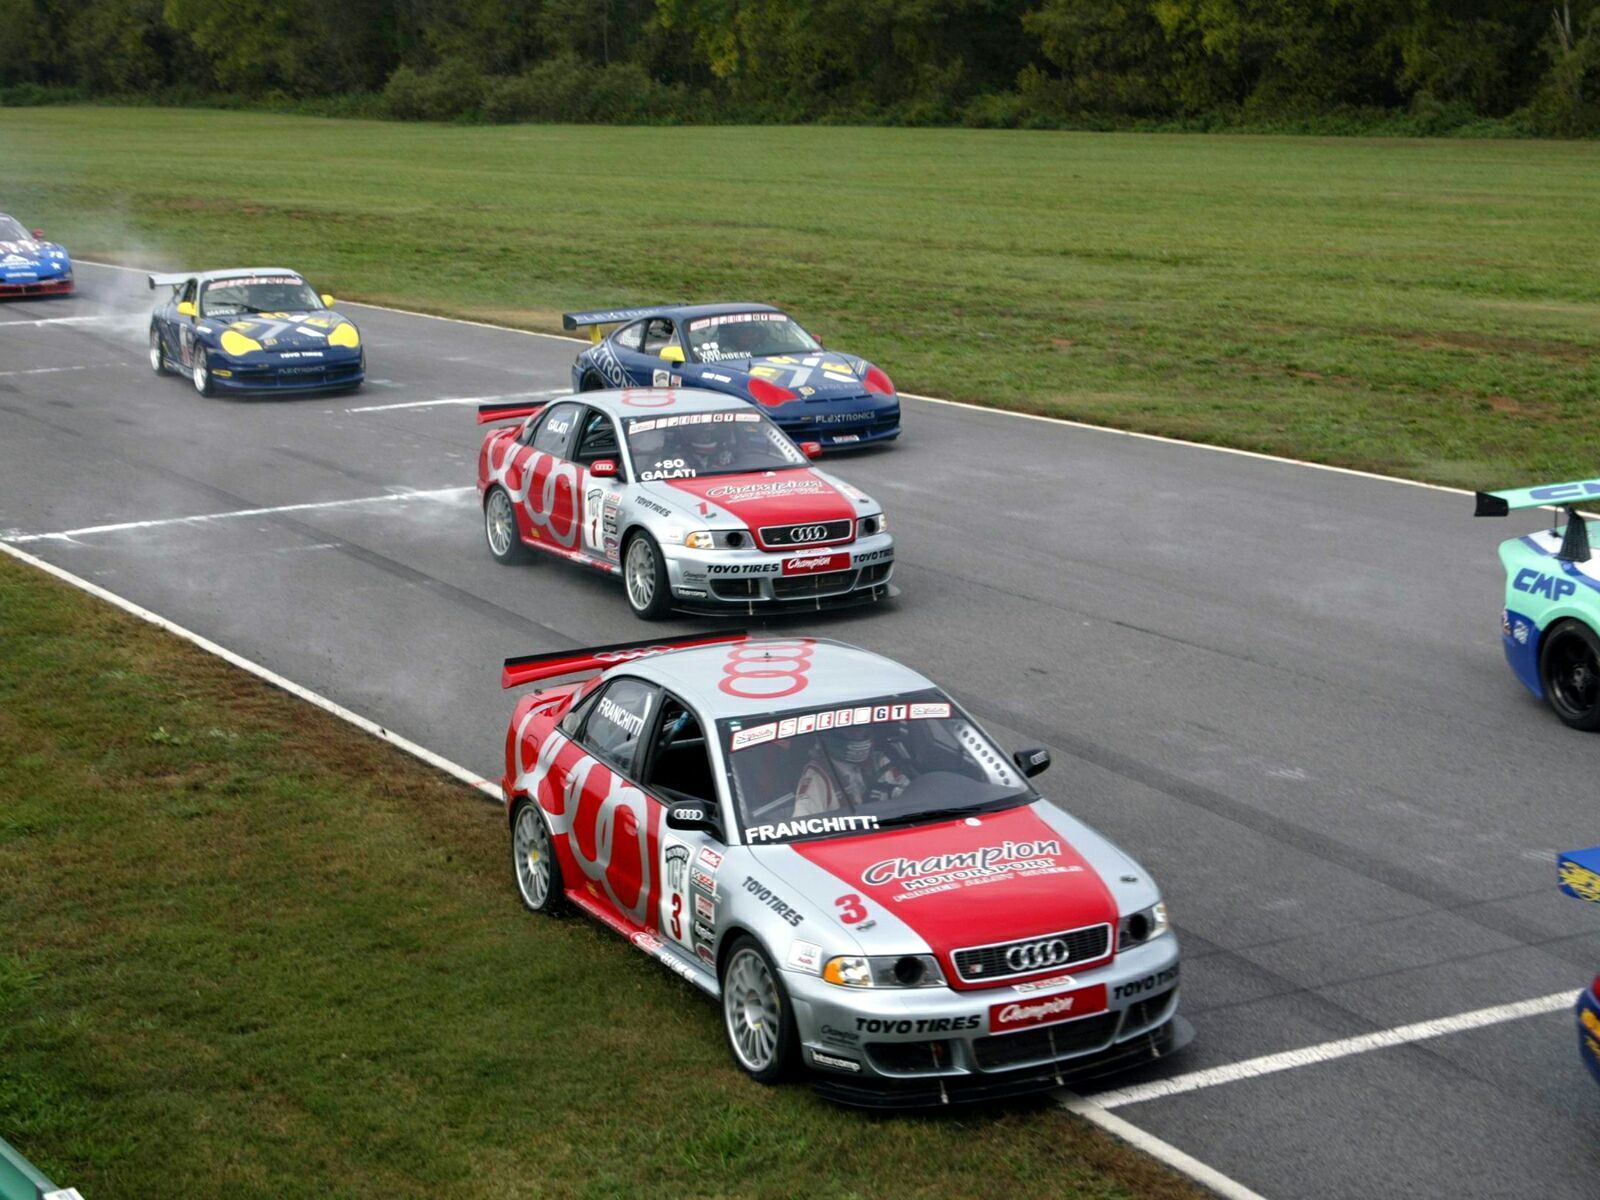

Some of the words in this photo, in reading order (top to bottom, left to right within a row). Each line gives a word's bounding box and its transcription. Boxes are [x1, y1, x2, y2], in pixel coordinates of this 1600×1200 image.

[641, 469, 696, 481] GALATI
[592, 518, 598, 548] 1
[707, 565, 740, 574] TOYO
[741, 563, 780, 573] TIRES
[787, 555, 831, 570] Champion
[853, 552, 878, 563] TOYO
[1512, 567, 1577, 602] CMP
[597, 696, 644, 737] FRANCHITTI
[875, 706, 906, 720] GT
[861, 840, 1062, 886] Champion
[902, 857, 1055, 891] MOTORSPORT
[742, 875, 771, 901] TOYO
[766, 895, 804, 928] TIRES
[835, 894, 868, 924] 3
[670, 892, 682, 941] 3
[1113, 975, 1155, 1000] TOYO
[997, 996, 1075, 1023] Champion
[855, 1017, 913, 1034] TOYO
[914, 1014, 982, 1034] TIRES
